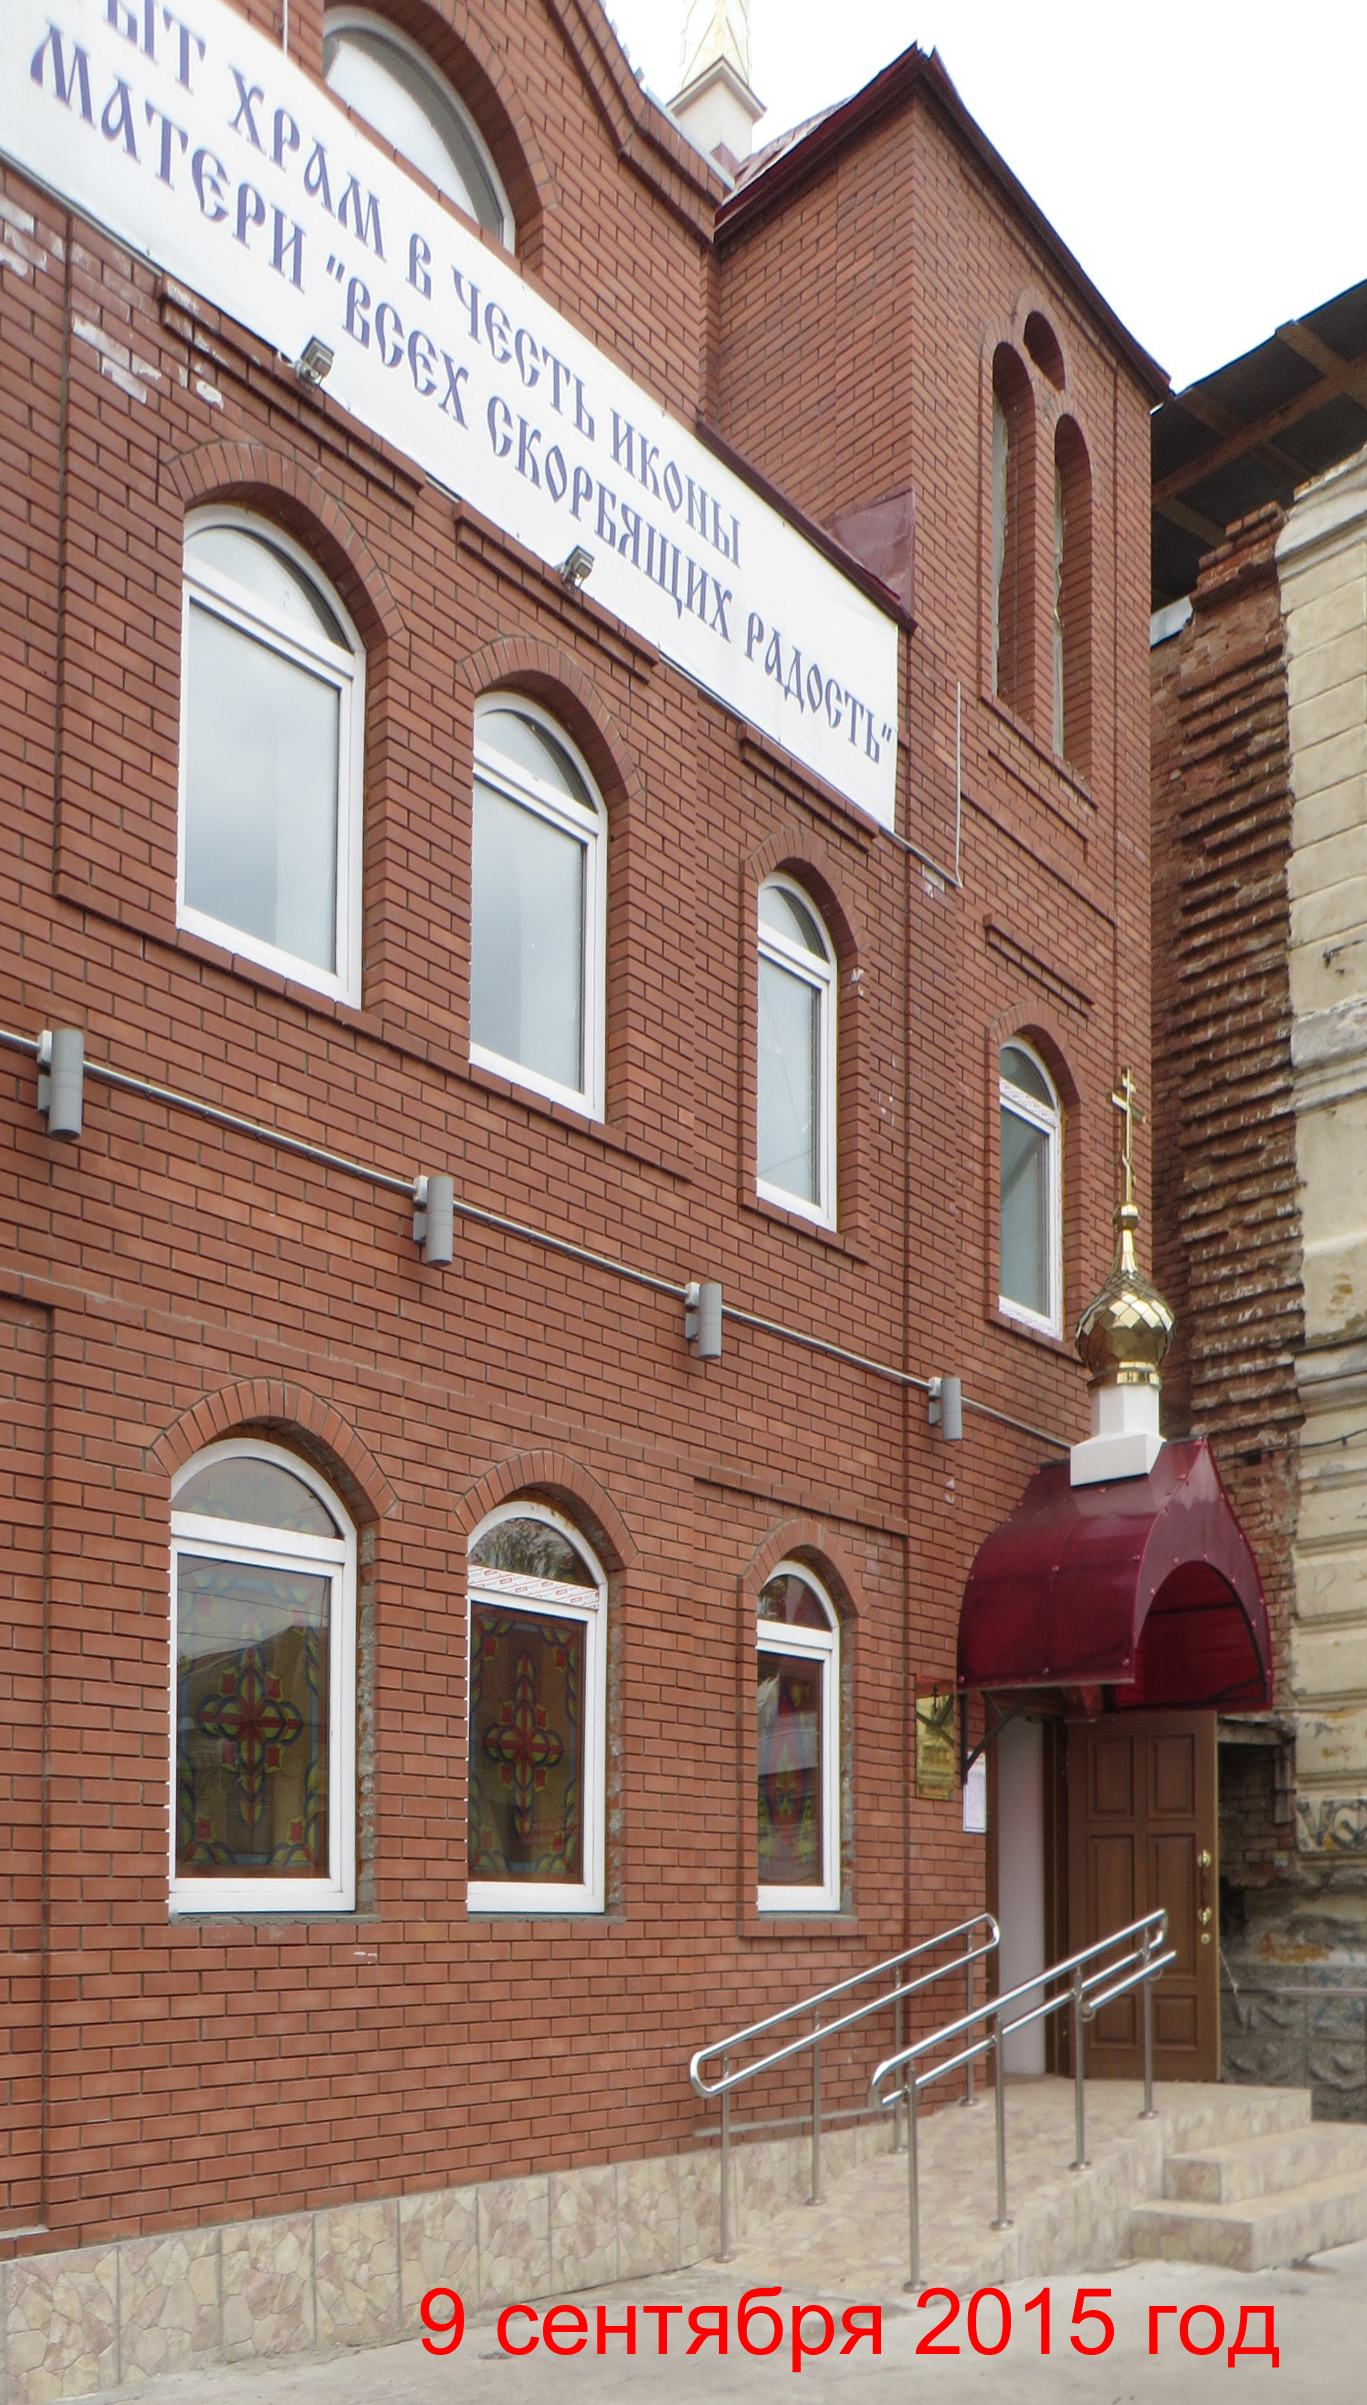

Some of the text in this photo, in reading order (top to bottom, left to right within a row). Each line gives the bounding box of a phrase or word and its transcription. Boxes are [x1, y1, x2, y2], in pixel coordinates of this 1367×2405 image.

[30, 16, 306, 295] МАТЕРИ
[486, 395, 734, 643] СКОРБЯЩИХ
[745, 611, 893, 765] РАДОСТЬ"
[228, 63, 387, 264] ХРАМ
[405, 233, 433, 301] В
[450, 265, 596, 442] ЧЕСТЬ
[610, 407, 742, 570] ИКОНЫ
